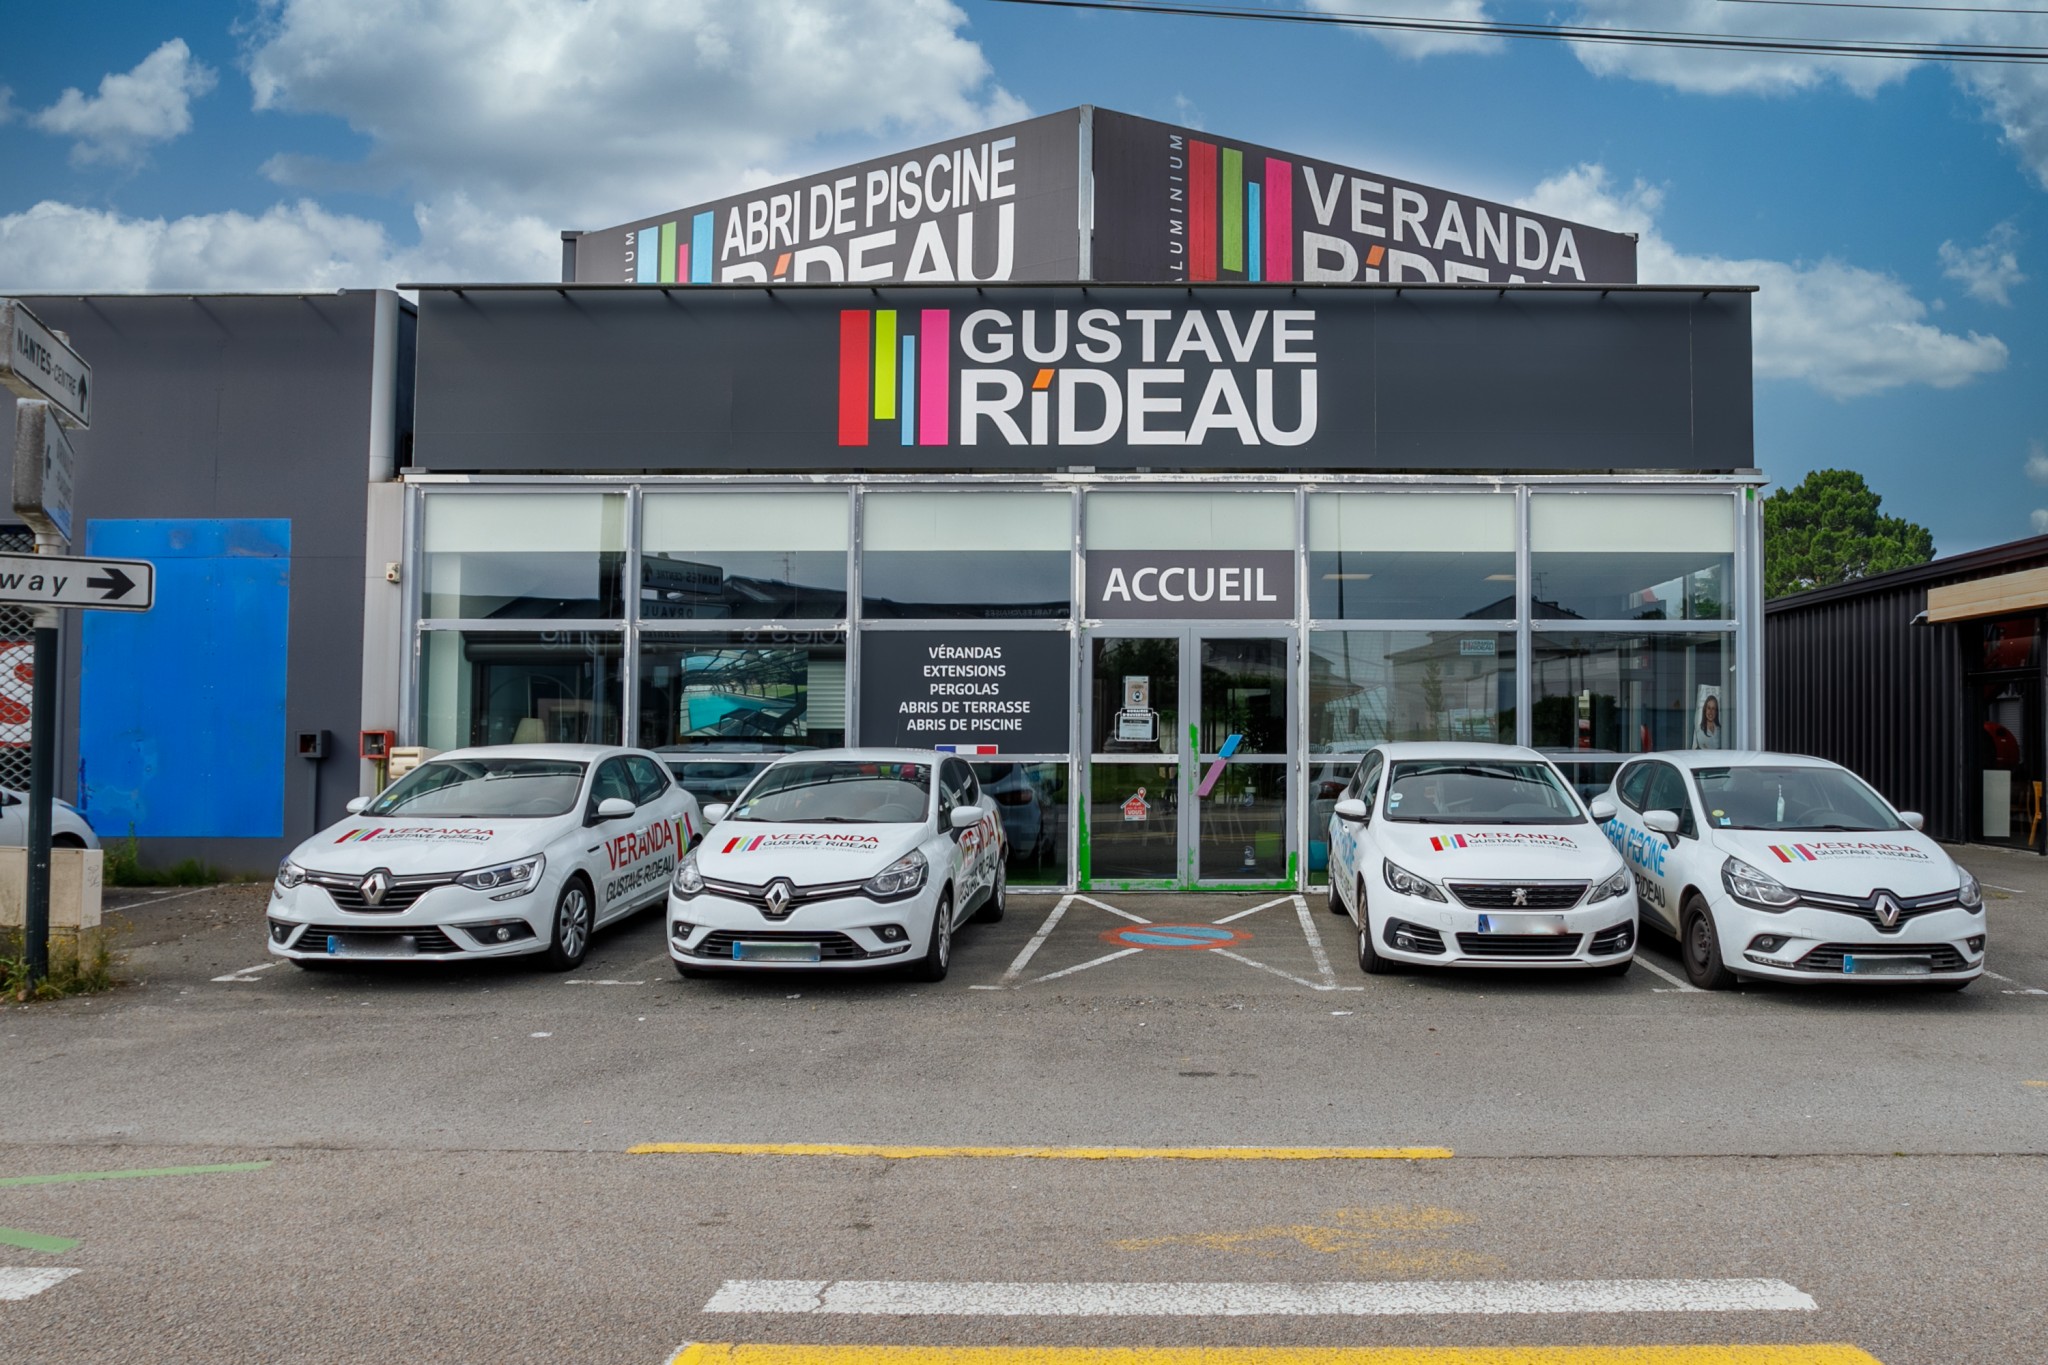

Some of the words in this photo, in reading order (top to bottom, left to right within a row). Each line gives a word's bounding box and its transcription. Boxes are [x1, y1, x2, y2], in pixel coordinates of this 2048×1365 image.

[721, 190, 800, 261] ABRI
[809, 176, 857, 241] DE
[866, 136, 1016, 227] PISCINE
[1302, 165, 1586, 281] VERANDA
[960, 308, 1317, 363] GUSTAVE
[1102, 567, 1277, 602] ACCUEIL
[928, 644, 1001, 659] VÉRANDAS
[923, 665, 1006, 678] EXTENSIONS
[930, 683, 999, 696] PERGOLAS
[899, 701, 938, 714] ABRIS
[942, 701, 959, 714] DE
[963, 701, 1030, 714] TERRASSE
[906, 718, 946, 732] ABRIS
[950, 718, 967, 732] DE
[971, 718, 1022, 732] PISCINE
[390, 827, 494, 835] VERANDA
[771, 833, 879, 843] VERANDA
[1466, 833, 1574, 843] VERANDA
[605, 819, 674, 871] VERANDA
[1807, 841, 1921, 852] VERANDA
[1627, 828, 1669, 877] PISCINE
